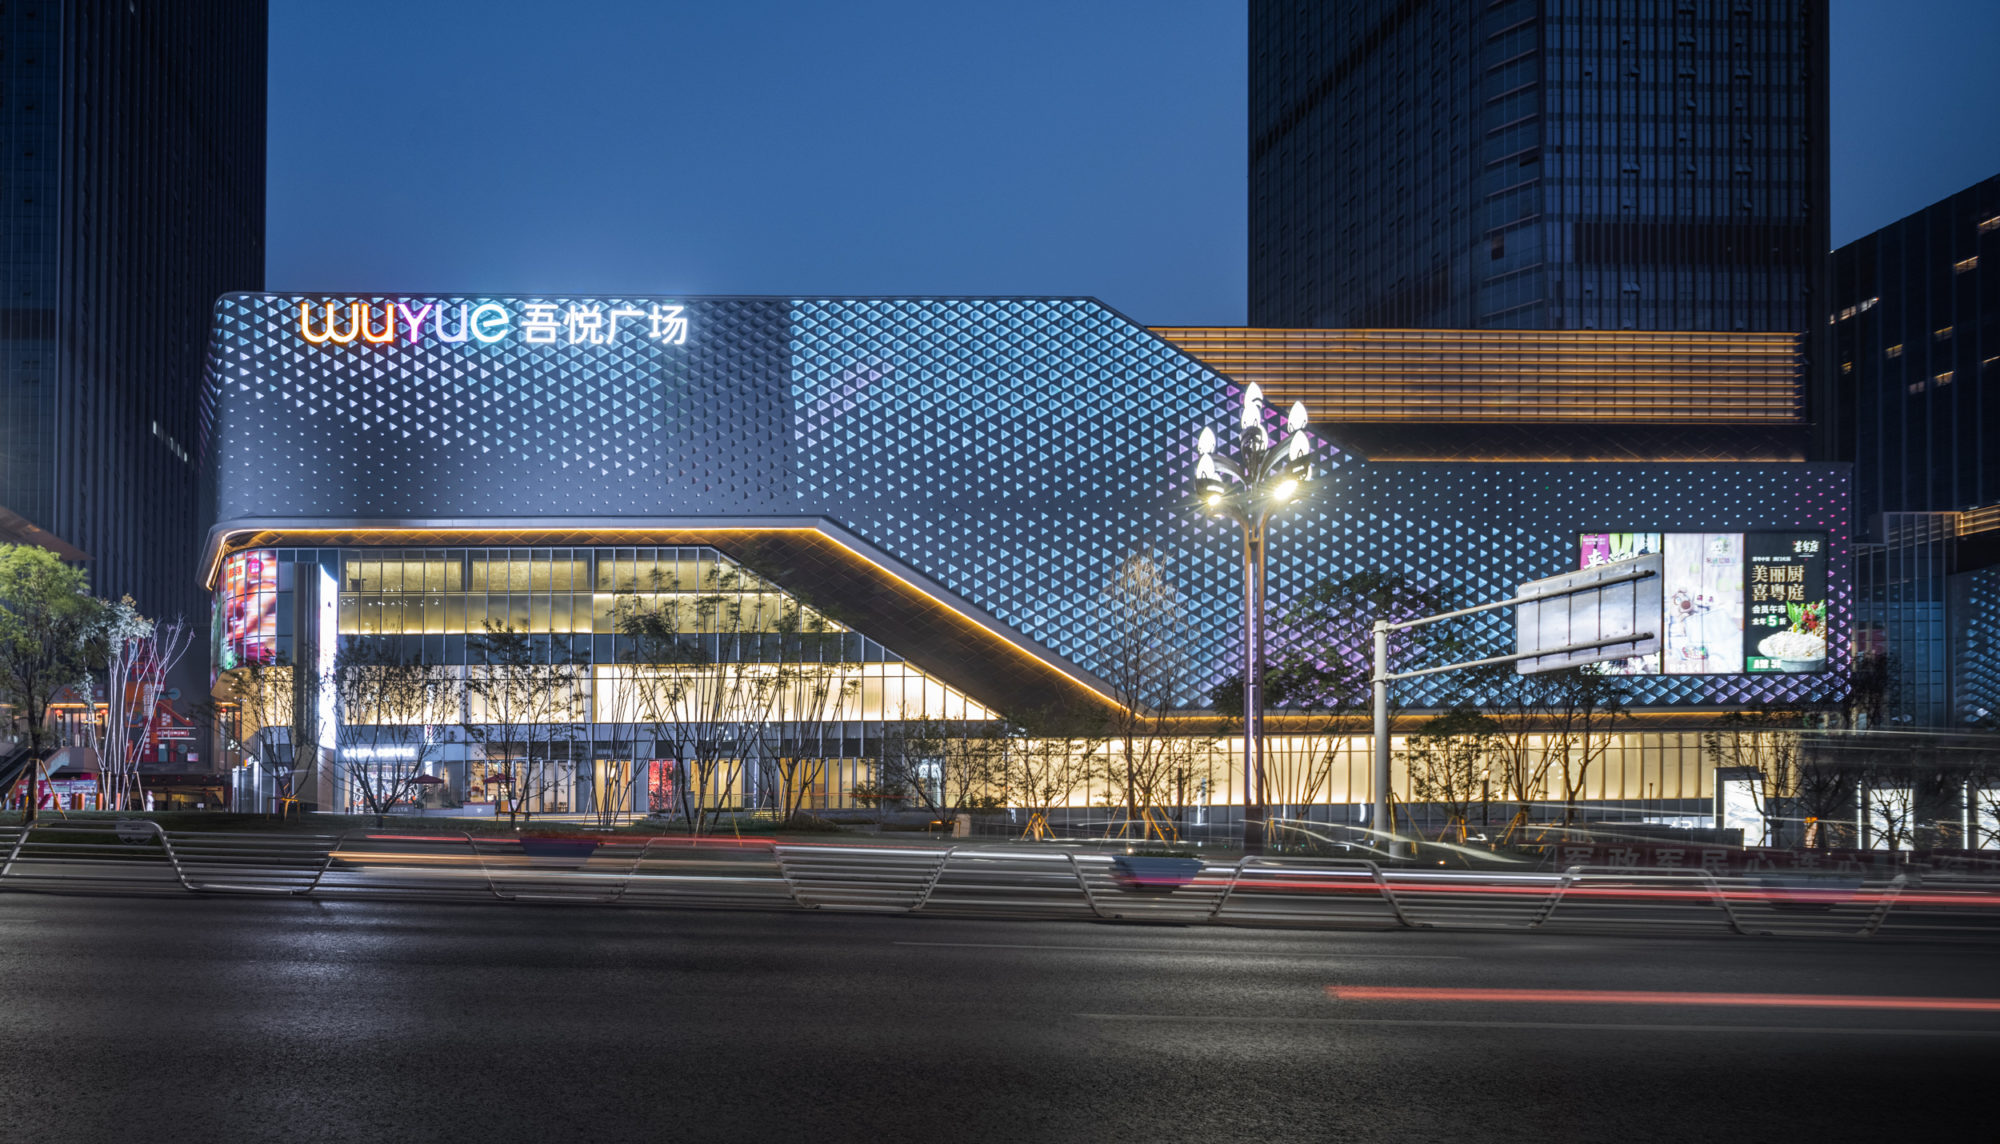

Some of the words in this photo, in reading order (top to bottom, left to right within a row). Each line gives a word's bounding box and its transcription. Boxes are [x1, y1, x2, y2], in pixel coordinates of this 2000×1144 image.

[521, 303, 689, 345] 吾悦广场
[1752, 565, 1804, 582] 美丽厨
[1752, 583, 1804, 601] 喜粤庭
[1752, 605, 1786, 614] 会员午市
